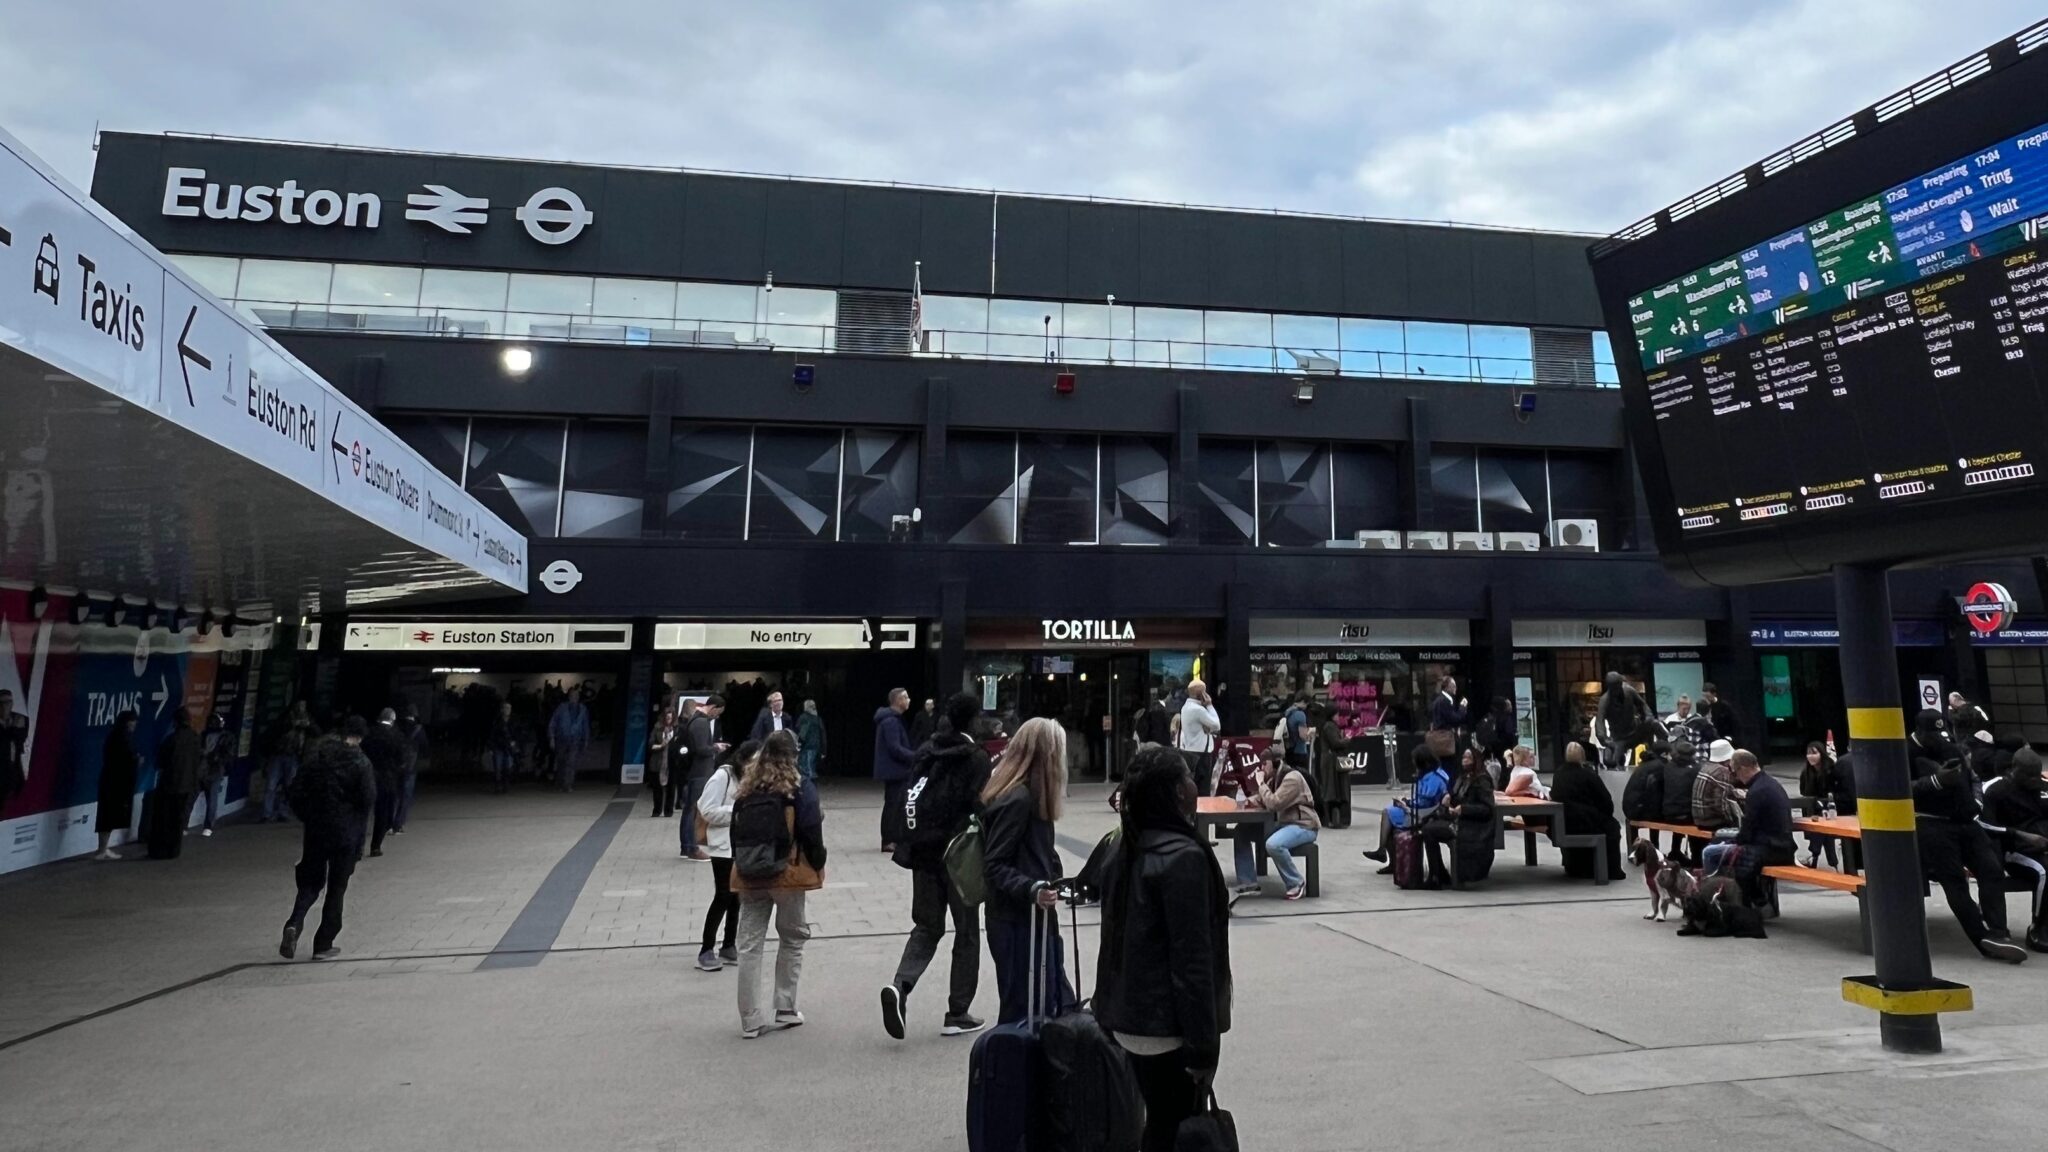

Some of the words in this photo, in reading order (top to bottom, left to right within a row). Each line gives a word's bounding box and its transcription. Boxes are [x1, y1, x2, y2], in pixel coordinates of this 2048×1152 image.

[1975, 150, 2000, 167] 17:04
[1922, 164, 1968, 188] Preparing
[1979, 168, 2014, 189] Tring
[162, 167, 382, 229] Euston
[1988, 198, 2020, 218] Wait
[1822, 270, 1836, 285] 13
[78, 254, 145, 352] Taxis
[1693, 320, 1699, 331] 6
[1638, 340, 1645, 351] 2
[248, 368, 296, 442] Euston
[300, 403, 316, 452] Rd
[365, 448, 395, 497] Euston
[396, 468, 419, 513] Square
[442, 630, 497, 645] Euston
[500, 630, 555, 644] Station
[751, 630, 771, 643] No
[774, 631, 812, 646] entry
[1042, 620, 1135, 639] TORTILLA
[1340, 623, 1370, 638] itsu
[1588, 624, 1614, 640] itsu
[87, 691, 143, 727] TRAINS
[904, 776, 929, 830] adidas
